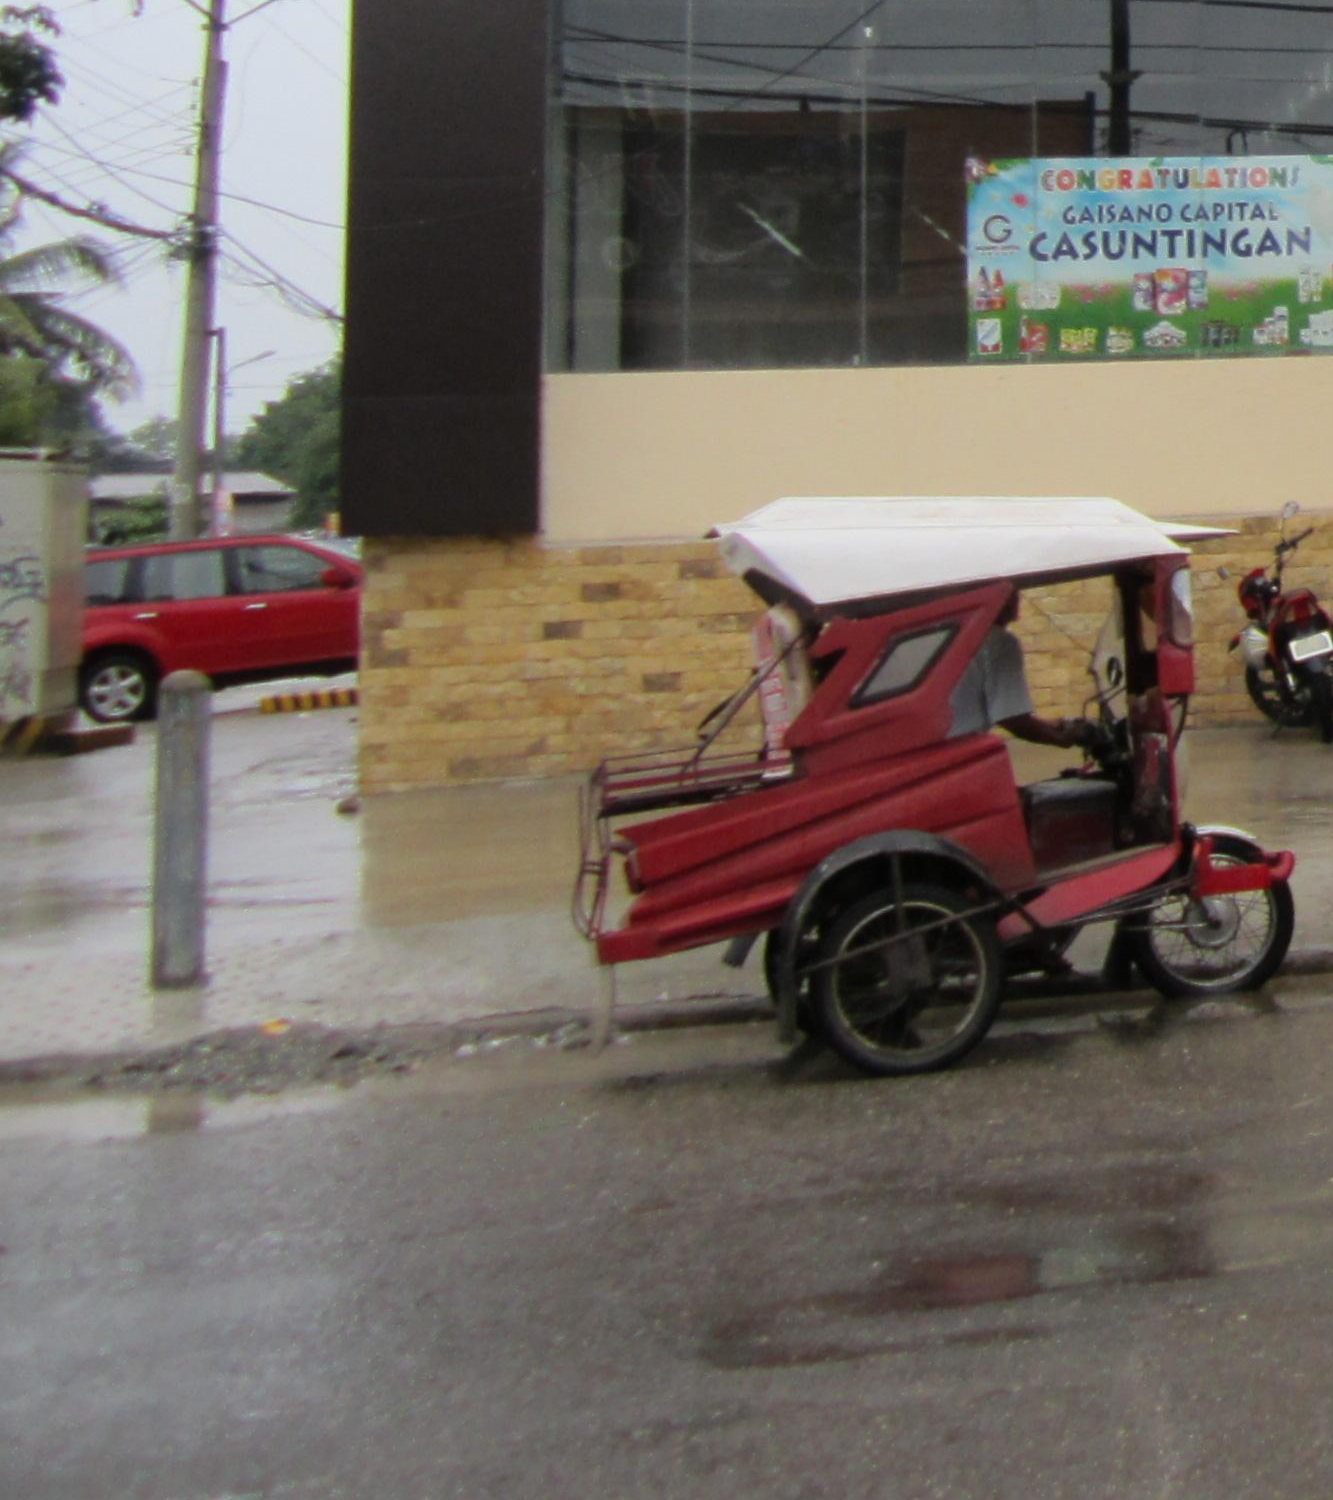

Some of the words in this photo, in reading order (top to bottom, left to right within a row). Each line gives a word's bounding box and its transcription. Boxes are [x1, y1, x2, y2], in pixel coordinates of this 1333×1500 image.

[1040, 166, 1301, 192] CONGRATULATIONS
[1061, 202, 1173, 226] GAISANO
[1179, 200, 1281, 223] CAPITAL
[1028, 225, 1313, 263] CASUNTINGAN
